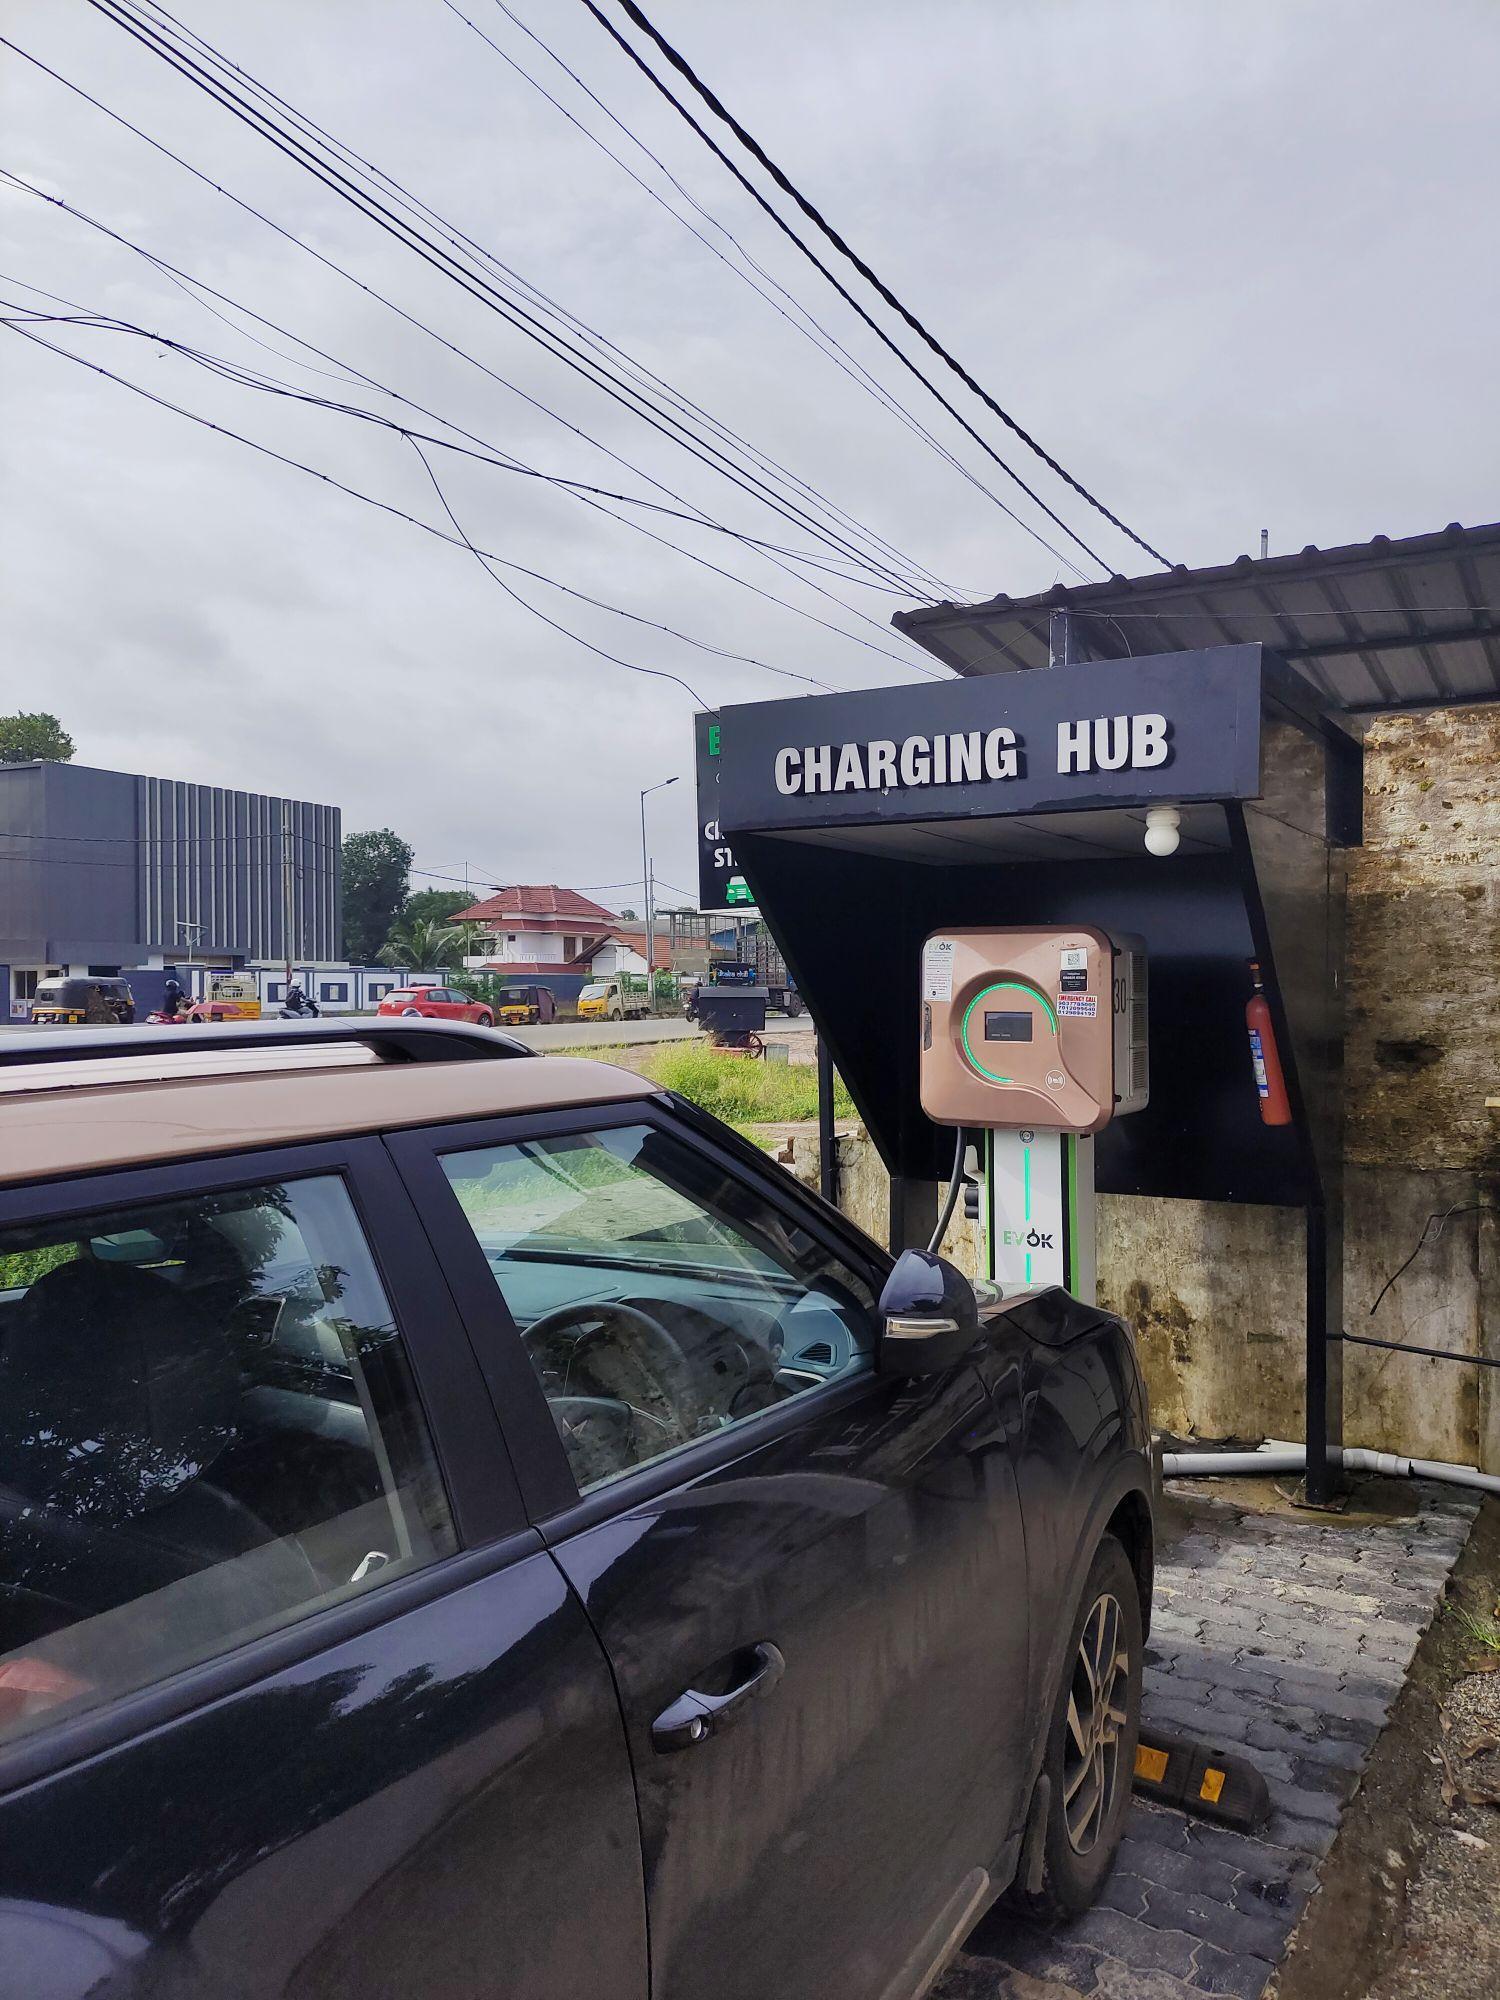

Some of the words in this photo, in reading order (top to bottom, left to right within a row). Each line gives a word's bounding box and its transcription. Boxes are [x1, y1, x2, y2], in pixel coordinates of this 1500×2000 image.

[774, 727, 1017, 794] CHARGING
[1057, 713, 1169, 773] HUB
[1113, 978, 1127, 1013] 30
[1003, 1228, 1054, 1249] EVOK
